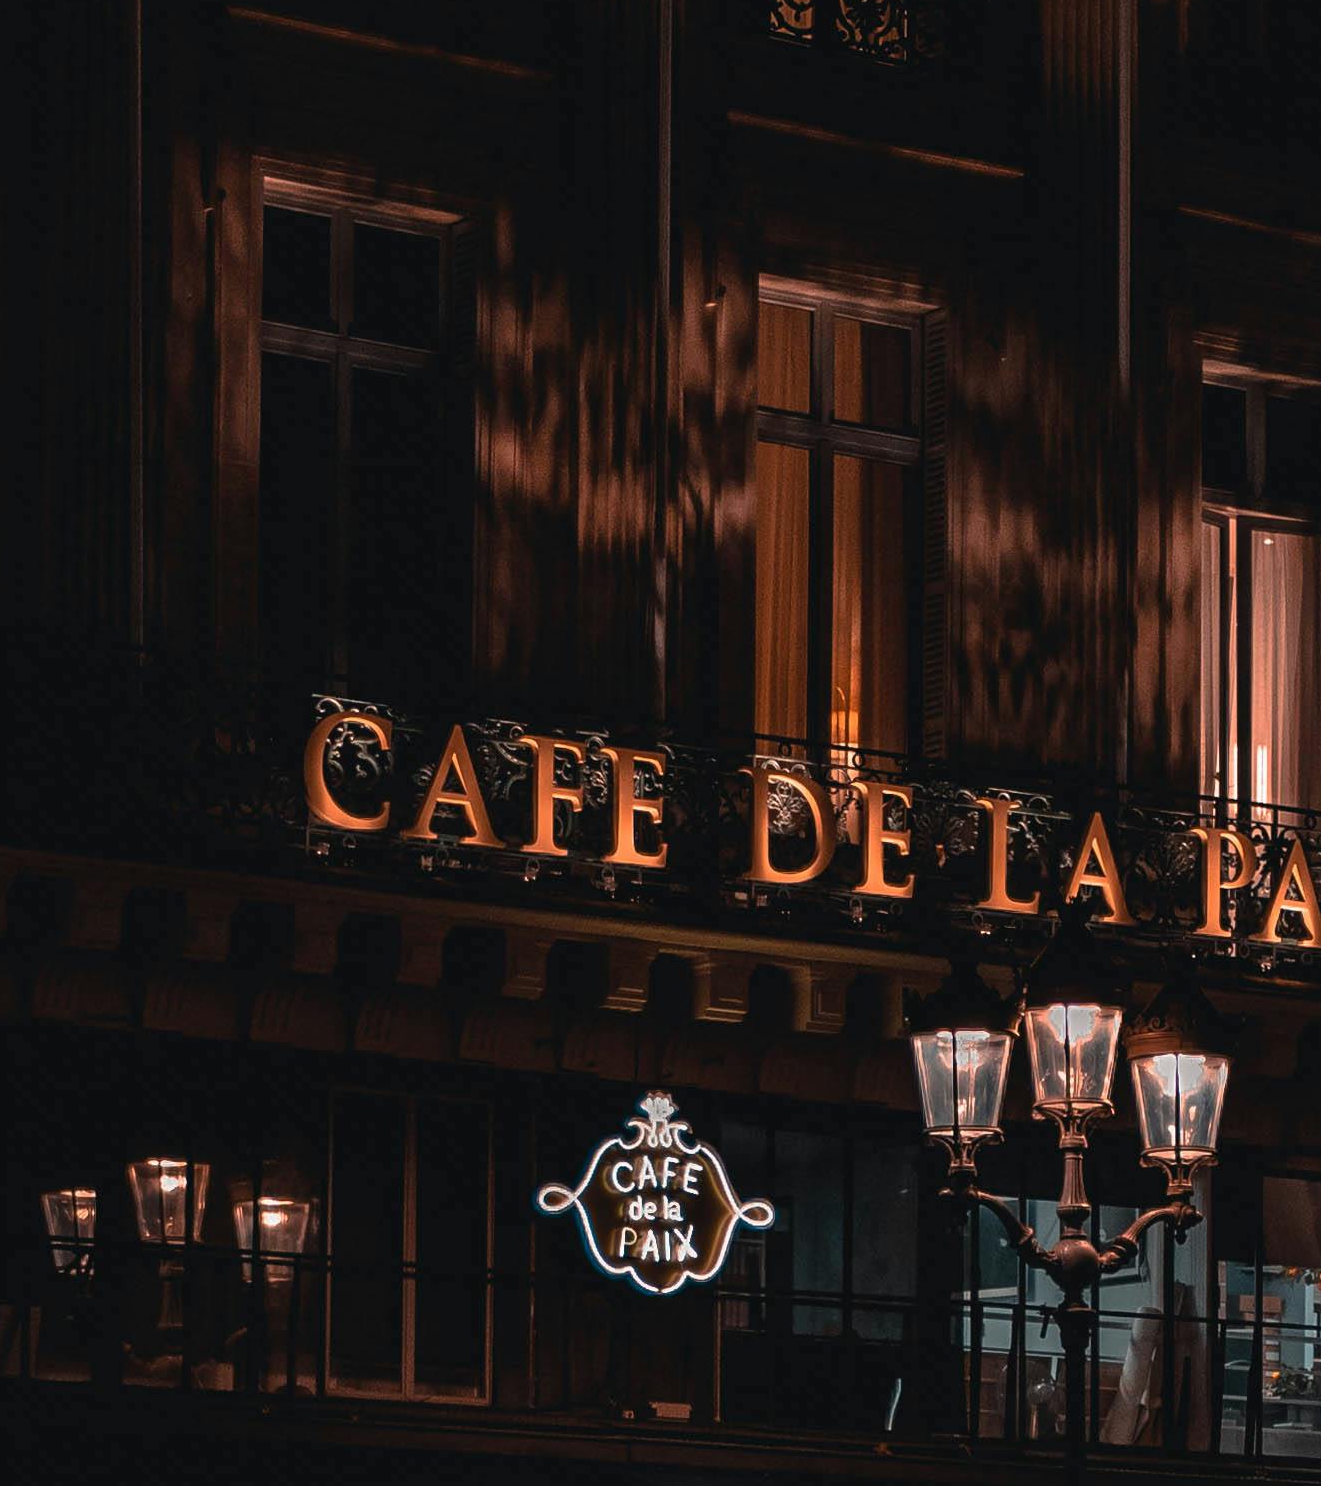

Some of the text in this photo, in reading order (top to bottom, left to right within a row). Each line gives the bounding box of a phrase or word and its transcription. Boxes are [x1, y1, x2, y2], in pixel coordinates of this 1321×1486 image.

[304, 711, 669, 870] CAFE
[740, 766, 917, 899] DE
[975, 796, 1138, 927] LA
[611, 1155, 704, 1196] CAFE
[629, 1195, 684, 1222] de la
[619, 1224, 698, 1263] PAIX
